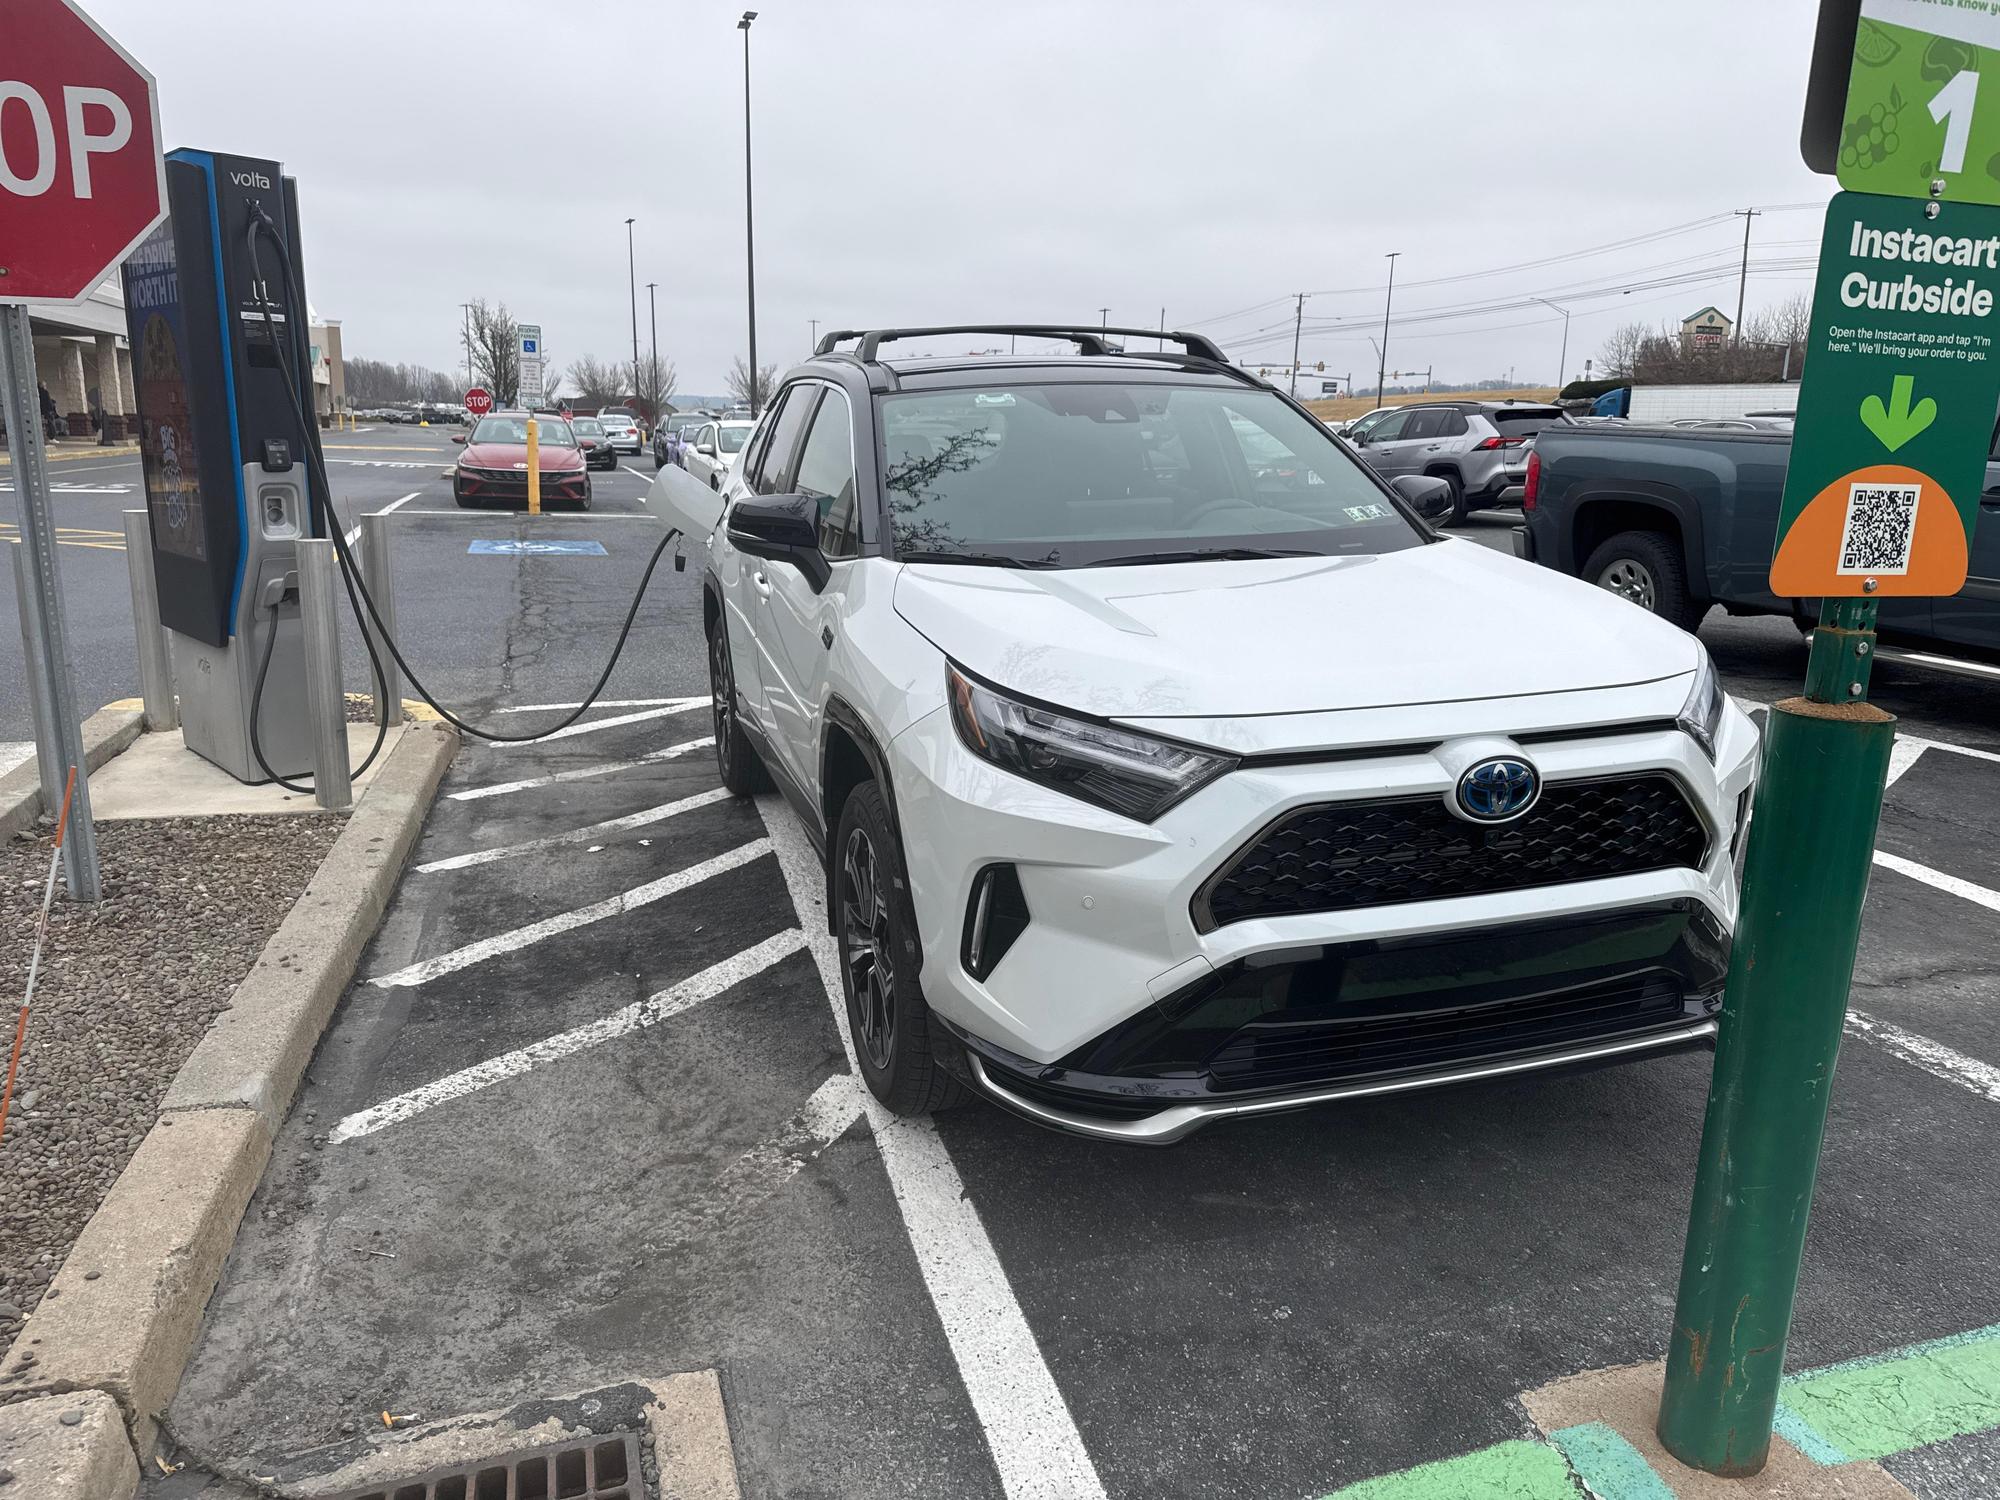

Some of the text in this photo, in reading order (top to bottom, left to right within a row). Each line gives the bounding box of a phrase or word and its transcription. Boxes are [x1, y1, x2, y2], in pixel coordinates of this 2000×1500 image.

[1957, 0, 1989, 11] know
[1927, 70, 1980, 173] 1
[0, 80, 132, 199] OP
[230, 171, 270, 189] volta
[144, 240, 177, 274] DRIVE
[1850, 220, 2000, 268] Instacart
[129, 273, 178, 309] WORTH IT
[1840, 272, 1993, 317] Curbside
[1829, 325, 1855, 339] Open
[1857, 327, 1873, 339] the
[1874, 328, 1916, 342] Instacart
[1917, 333, 1935, 345] app
[1936, 333, 1955, 344] and
[1956, 335, 1971, 347] tap
[1858, 342, 1881, 354] We'll
[1882, 343, 1907, 358] bring
[1907, 347, 1930, 358] your
[1930, 347, 1955, 359] order
[1956, 349, 1967, 359] to
[1967, 351, 1987, 362] you.
[466, 396, 490, 407] STOP
